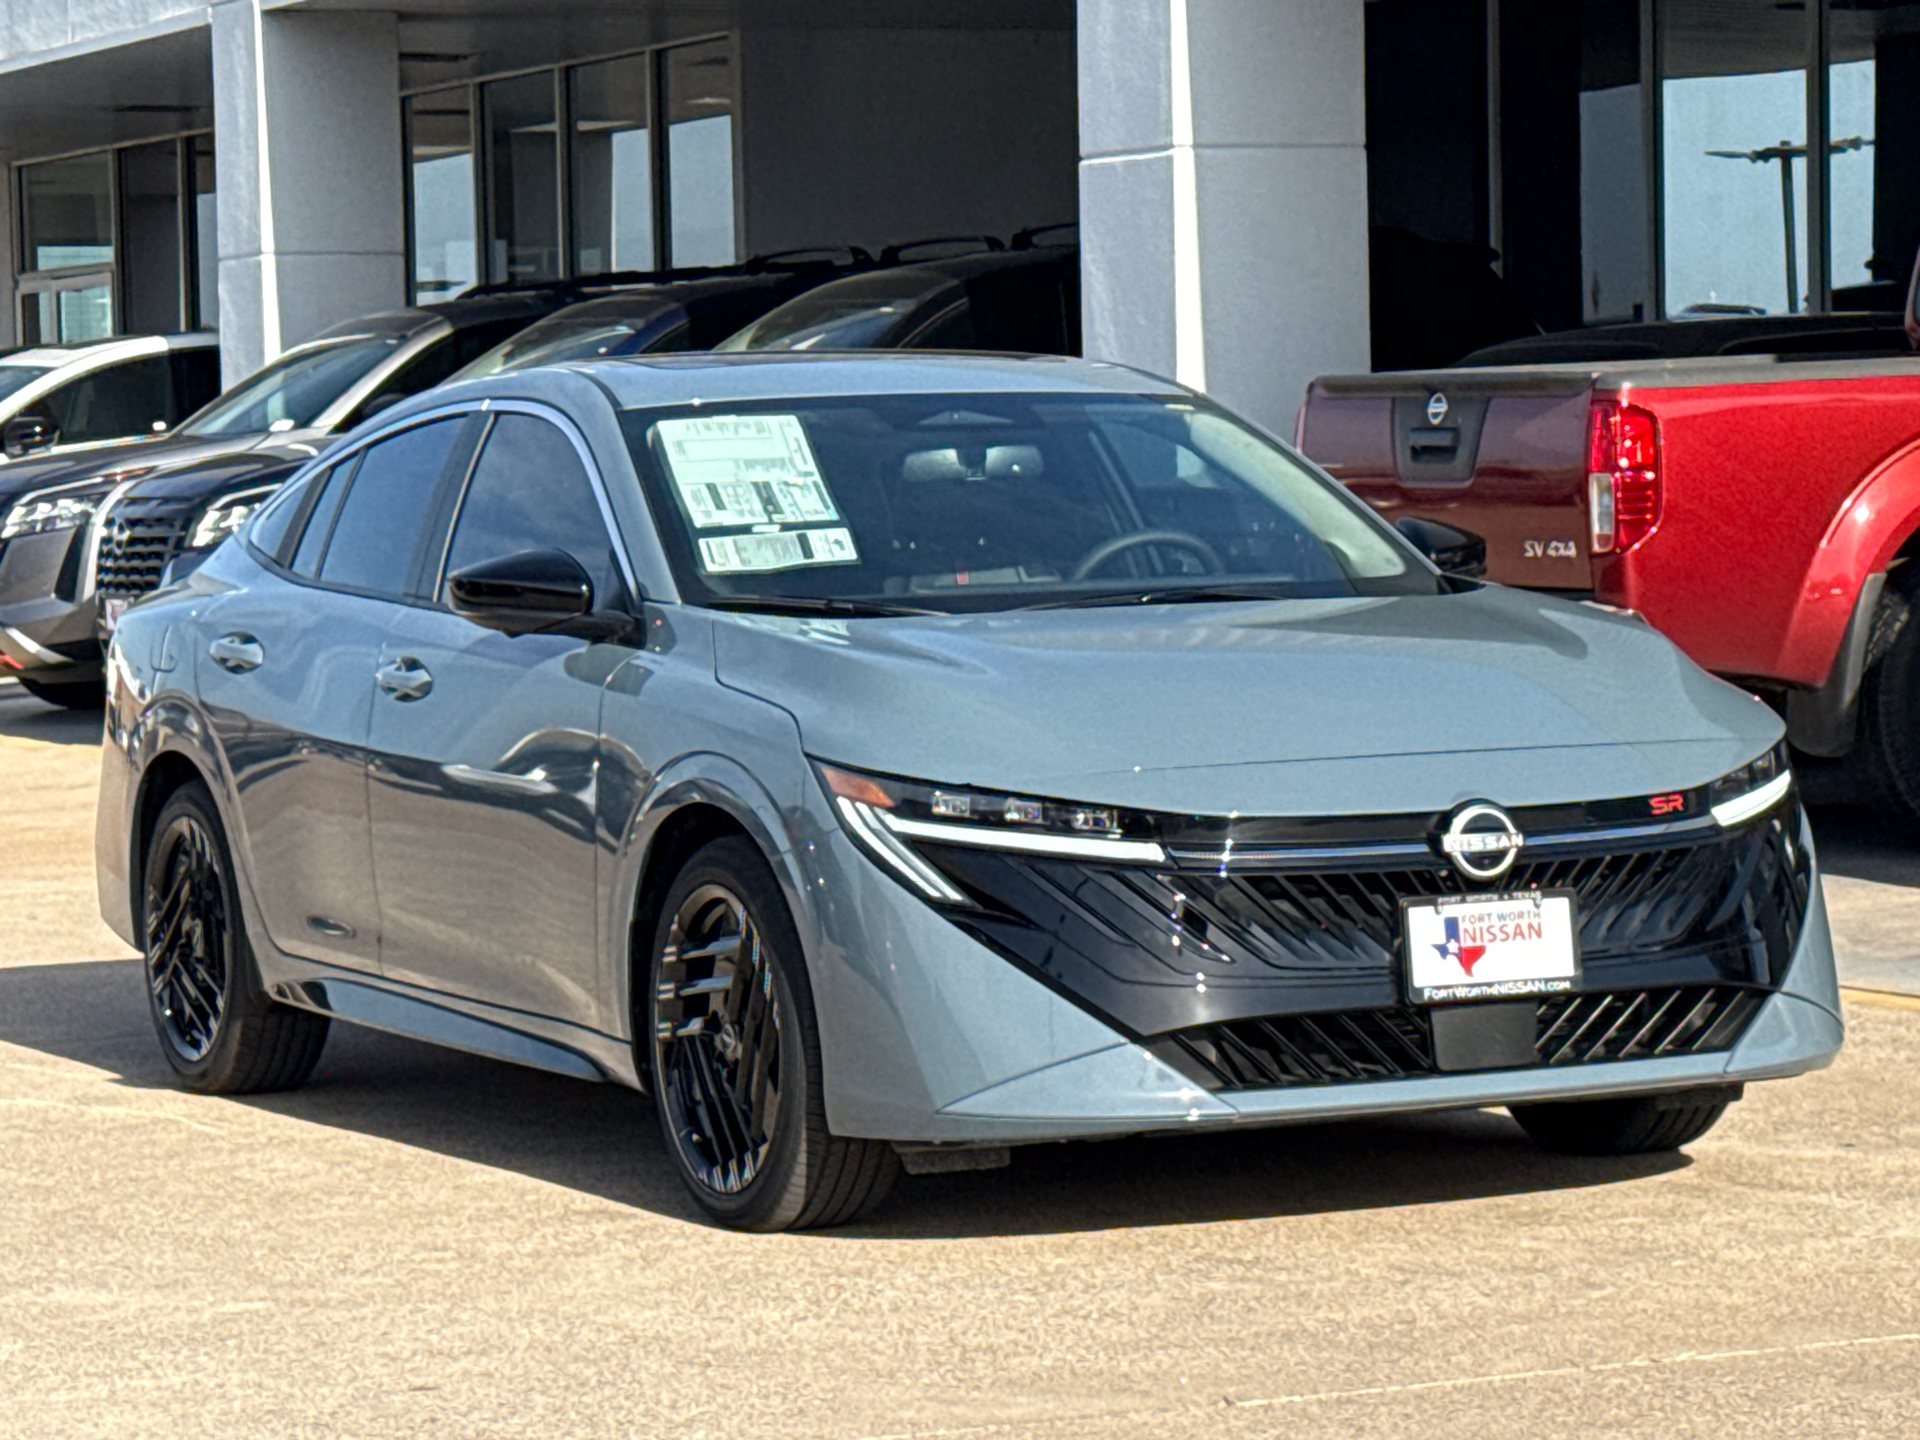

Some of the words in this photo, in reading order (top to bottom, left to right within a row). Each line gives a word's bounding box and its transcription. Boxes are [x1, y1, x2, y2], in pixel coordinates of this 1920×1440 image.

[1523, 540, 1545, 558] SV
[1649, 792, 1684, 815] SR
[1443, 831, 1524, 852] NISSAN
[1461, 912, 1493, 925] FORT
[1496, 909, 1542, 923] WORTH
[1462, 921, 1542, 943] NISSAN
